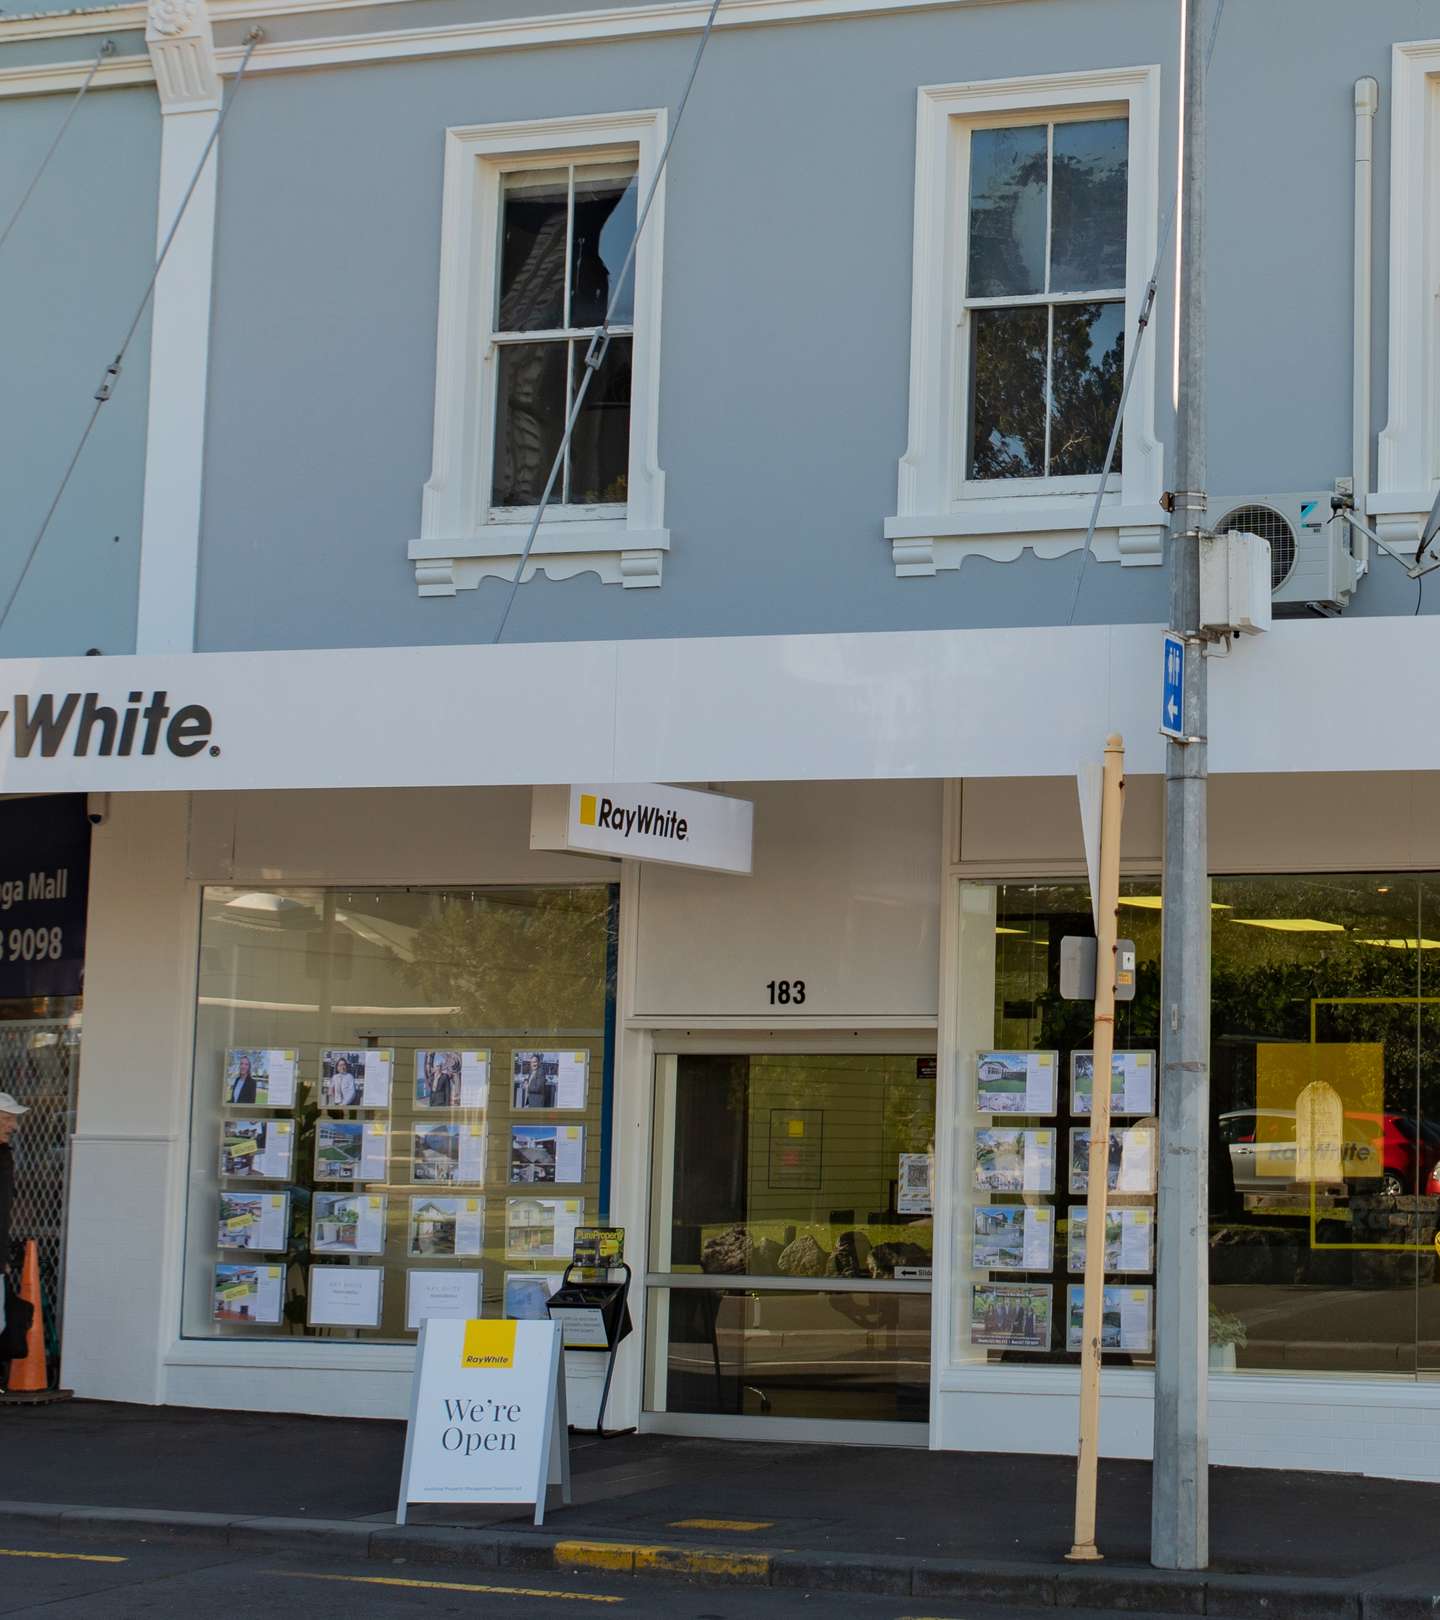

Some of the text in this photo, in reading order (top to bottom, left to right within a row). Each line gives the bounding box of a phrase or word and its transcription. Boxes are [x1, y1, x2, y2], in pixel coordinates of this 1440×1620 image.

[0, 868, 68, 910] ga Mall
[9, 926, 63, 962] 9098
[766, 980, 806, 1005] 183
[442, 1426, 517, 1456] Open
